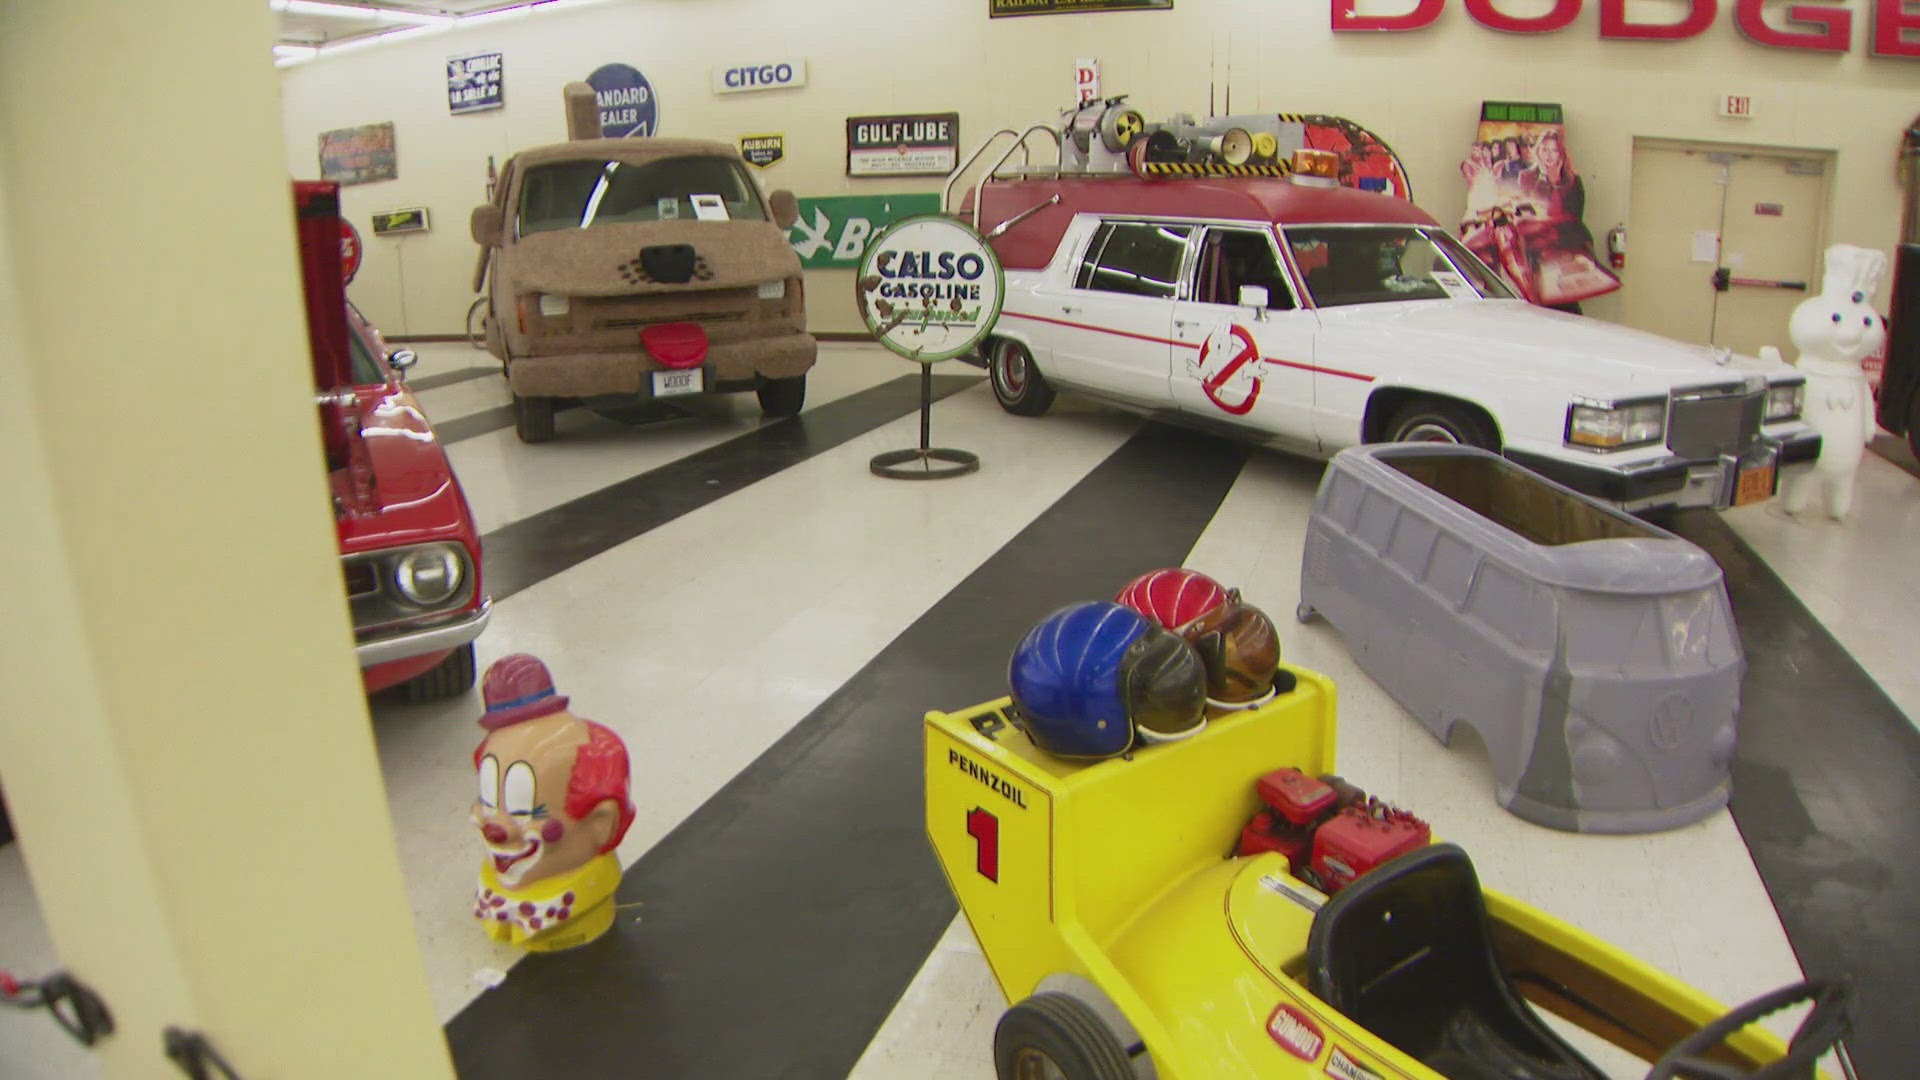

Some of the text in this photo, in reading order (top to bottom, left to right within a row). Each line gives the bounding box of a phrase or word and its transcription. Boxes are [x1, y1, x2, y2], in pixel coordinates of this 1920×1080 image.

[725, 63, 793, 88] CITGO
[596, 86, 649, 108] ANDARD
[1727, 95, 1751, 115] EXIT
[600, 108, 638, 127] EALER
[742, 137, 782, 151] AUBURN
[857, 121, 950, 144] GULFLUBE
[876, 250, 985, 281] CALSO
[879, 282, 980, 300] GASOLINE
[948, 748, 1028, 811] PENNZOIL
[966, 805, 999, 885] 1
[1271, 1008, 1323, 1058] GUMOUT
[1331, 1054, 1372, 1080] CHAMP
